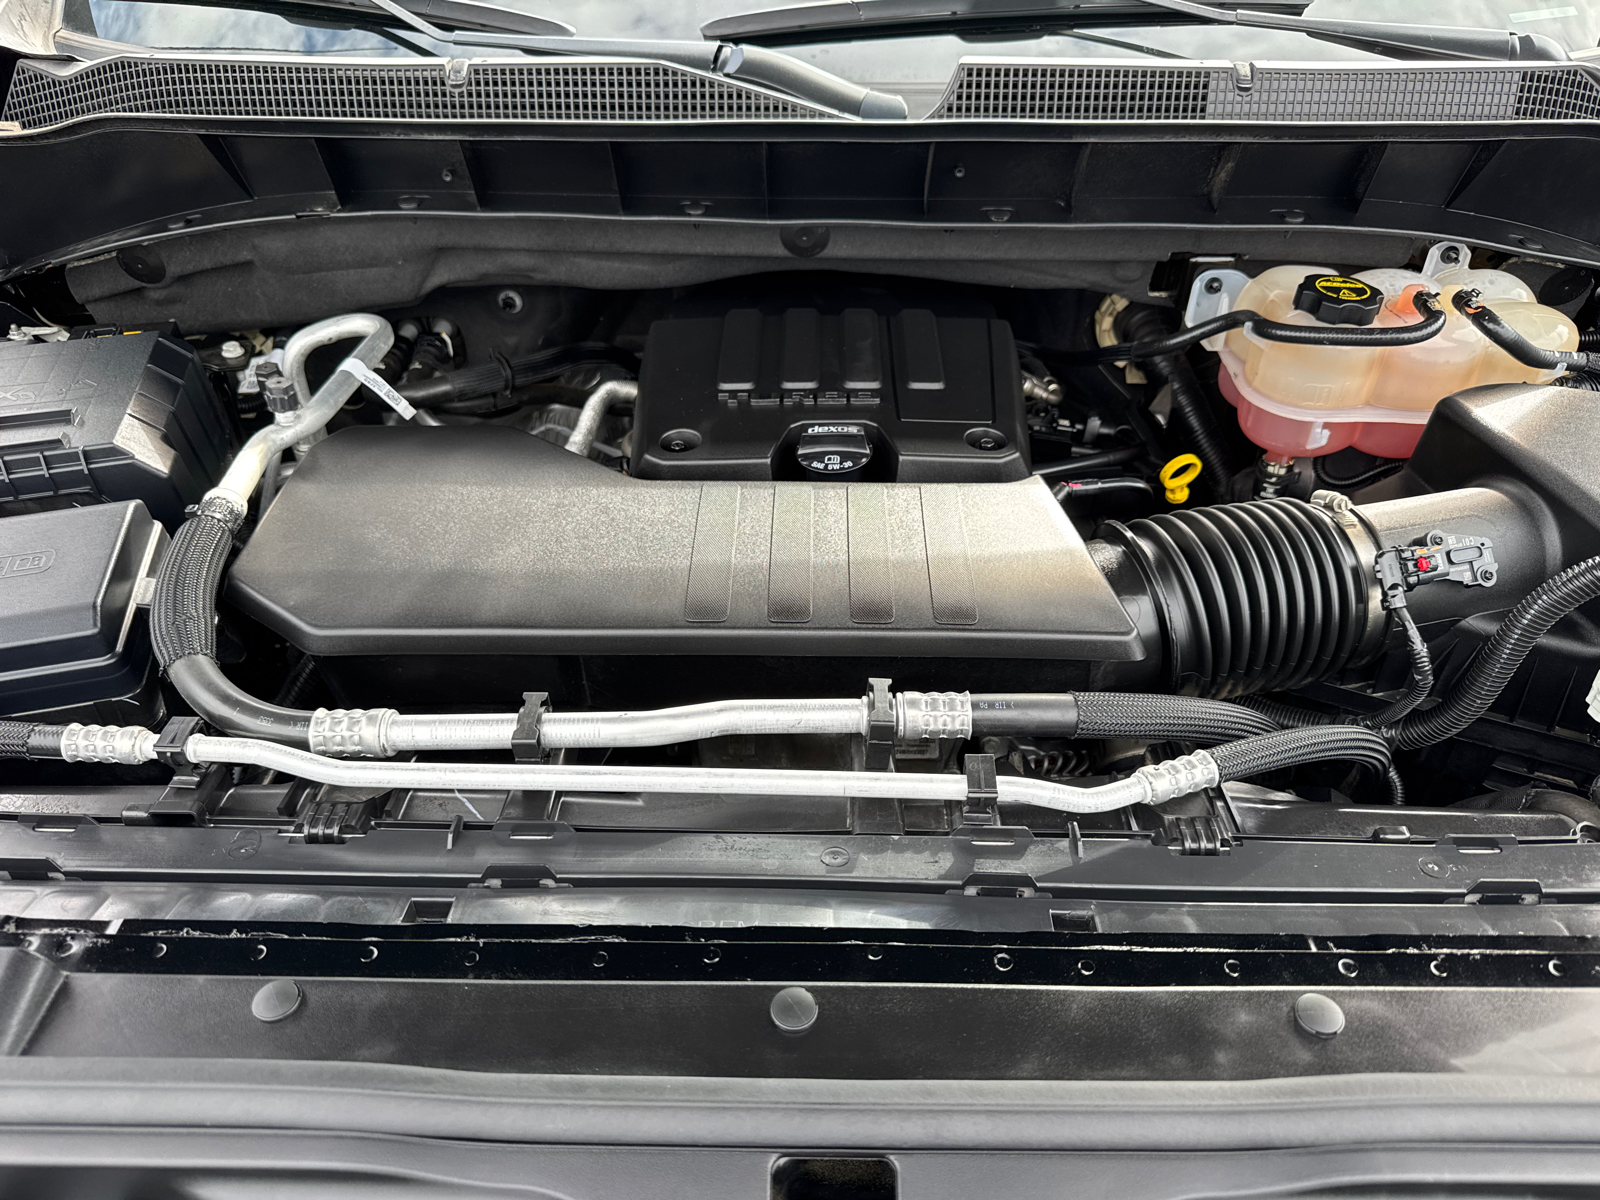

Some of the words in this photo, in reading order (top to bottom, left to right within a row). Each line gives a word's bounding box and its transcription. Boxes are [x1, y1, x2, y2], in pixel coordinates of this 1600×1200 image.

[807, 425, 858, 434] dexos
[811, 461, 826, 470] SAE
[827, 460, 853, 470] 5W-30
